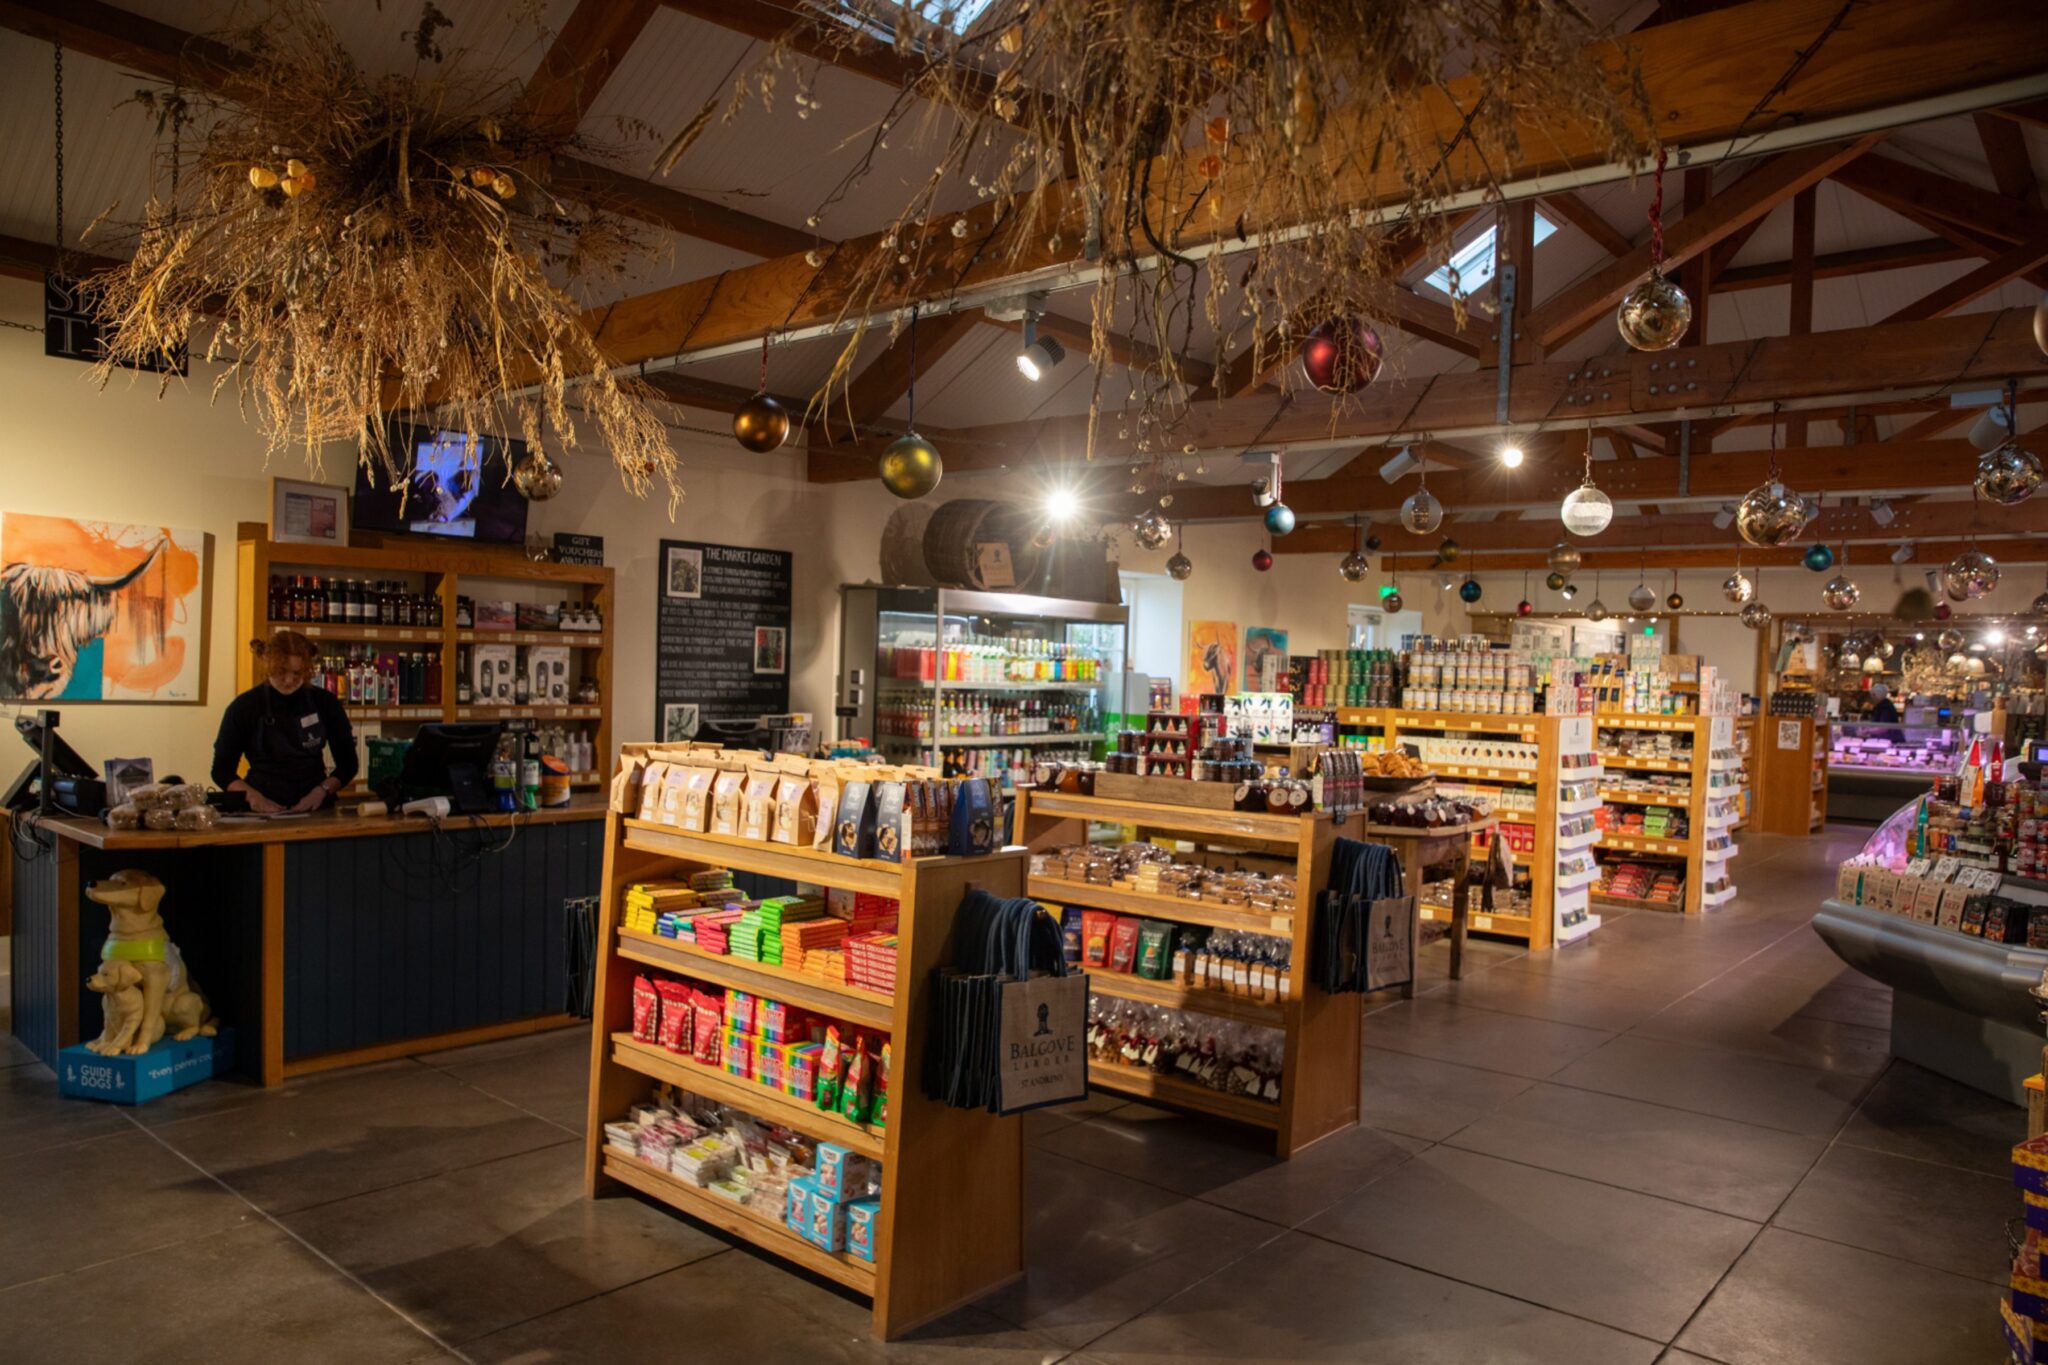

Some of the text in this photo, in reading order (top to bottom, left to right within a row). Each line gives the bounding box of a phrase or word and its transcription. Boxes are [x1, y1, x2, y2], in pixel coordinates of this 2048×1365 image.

[571, 536, 591, 546] GIFT
[558, 545, 603, 558] VOUCHERS
[705, 547, 782, 566] THE MARKET GARDEN
[1010, 1035, 1075, 1060] BALGOVE
[174, 1057, 198, 1073] penny
[1013, 1054, 1070, 1071] LARDER
[80, 1065, 113, 1079] GUIDE
[80, 1076, 112, 1090] DOGS
